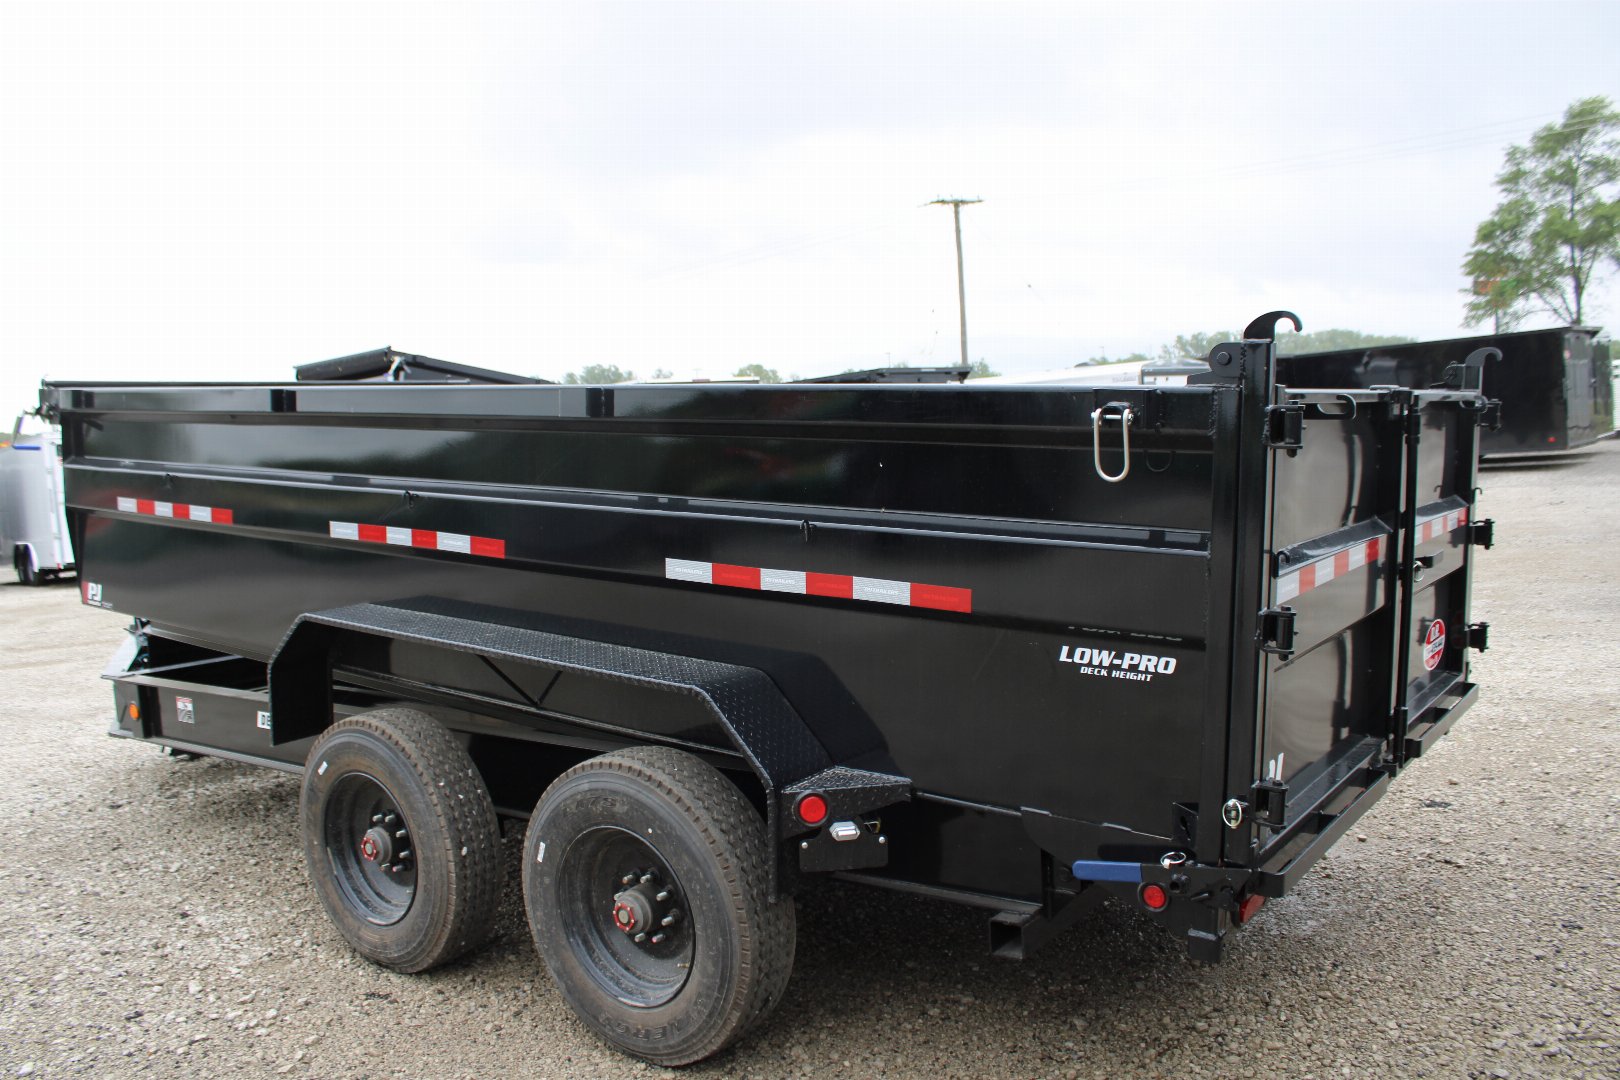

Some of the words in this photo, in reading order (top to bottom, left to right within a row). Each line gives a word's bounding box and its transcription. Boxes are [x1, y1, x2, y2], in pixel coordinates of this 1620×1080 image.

[1058, 645, 1177, 675] LOW-PRO
[1080, 666, 1108, 677] DECK
[1111, 670, 1153, 682] HEIGHT
